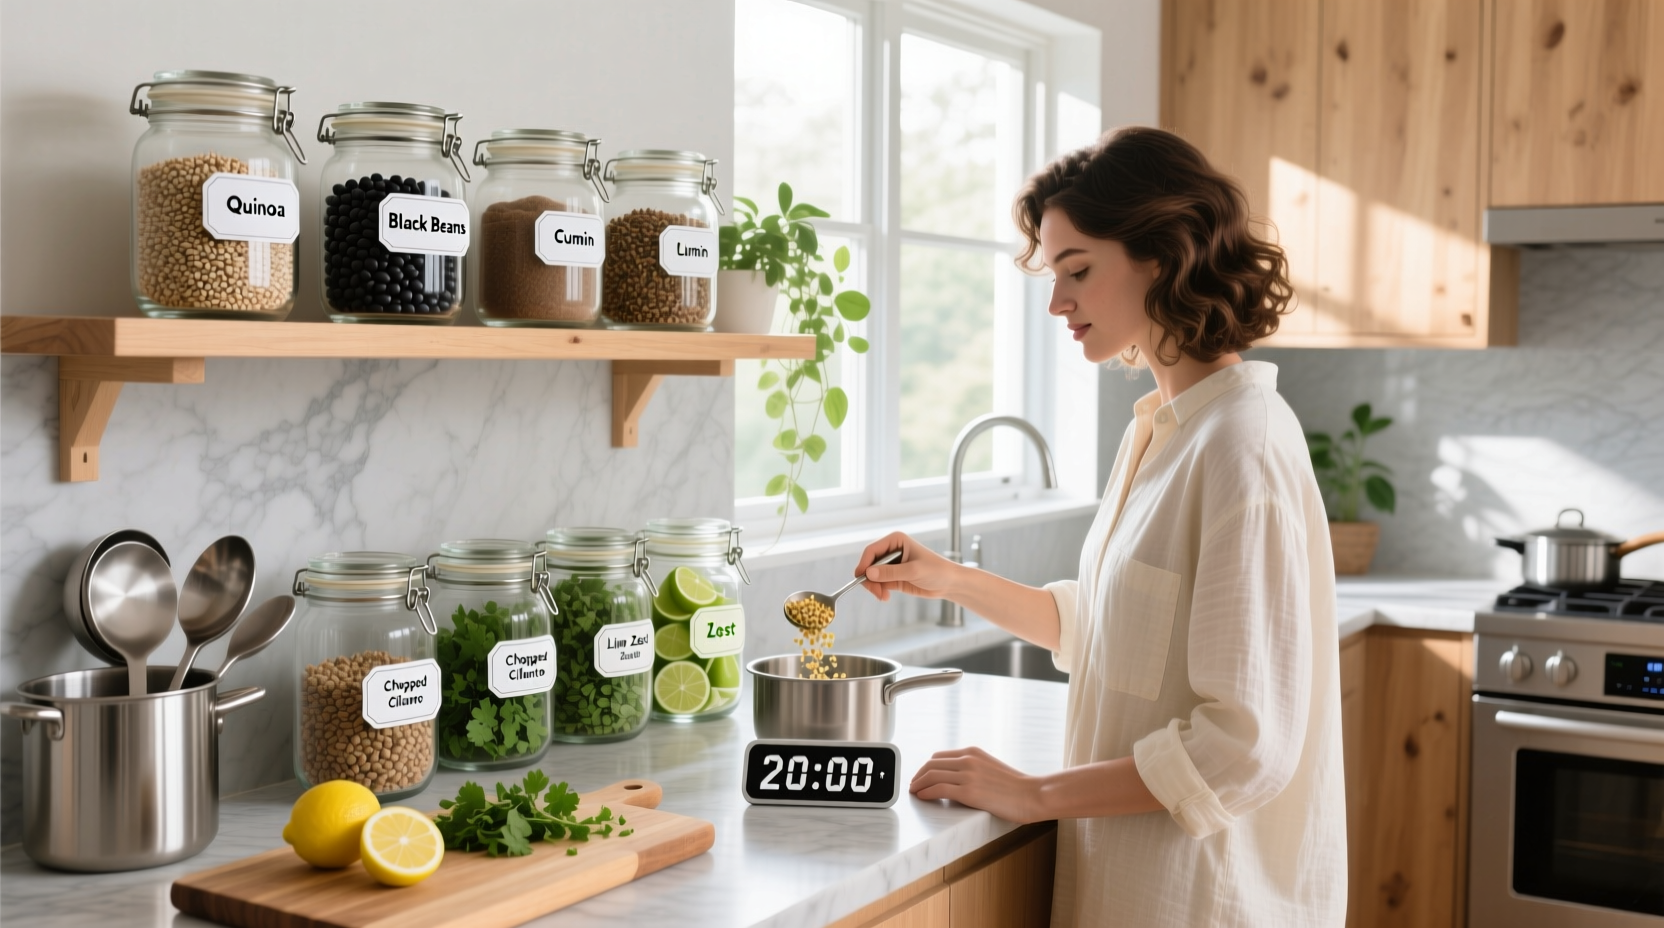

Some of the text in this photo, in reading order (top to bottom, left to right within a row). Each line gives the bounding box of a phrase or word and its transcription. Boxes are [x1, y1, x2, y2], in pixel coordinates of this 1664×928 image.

[226, 195, 286, 217] Quinoa
[388, 212, 467, 235] Black Beans
[554, 228, 595, 247] Cumin
[759, 754, 874, 793] 20:00
